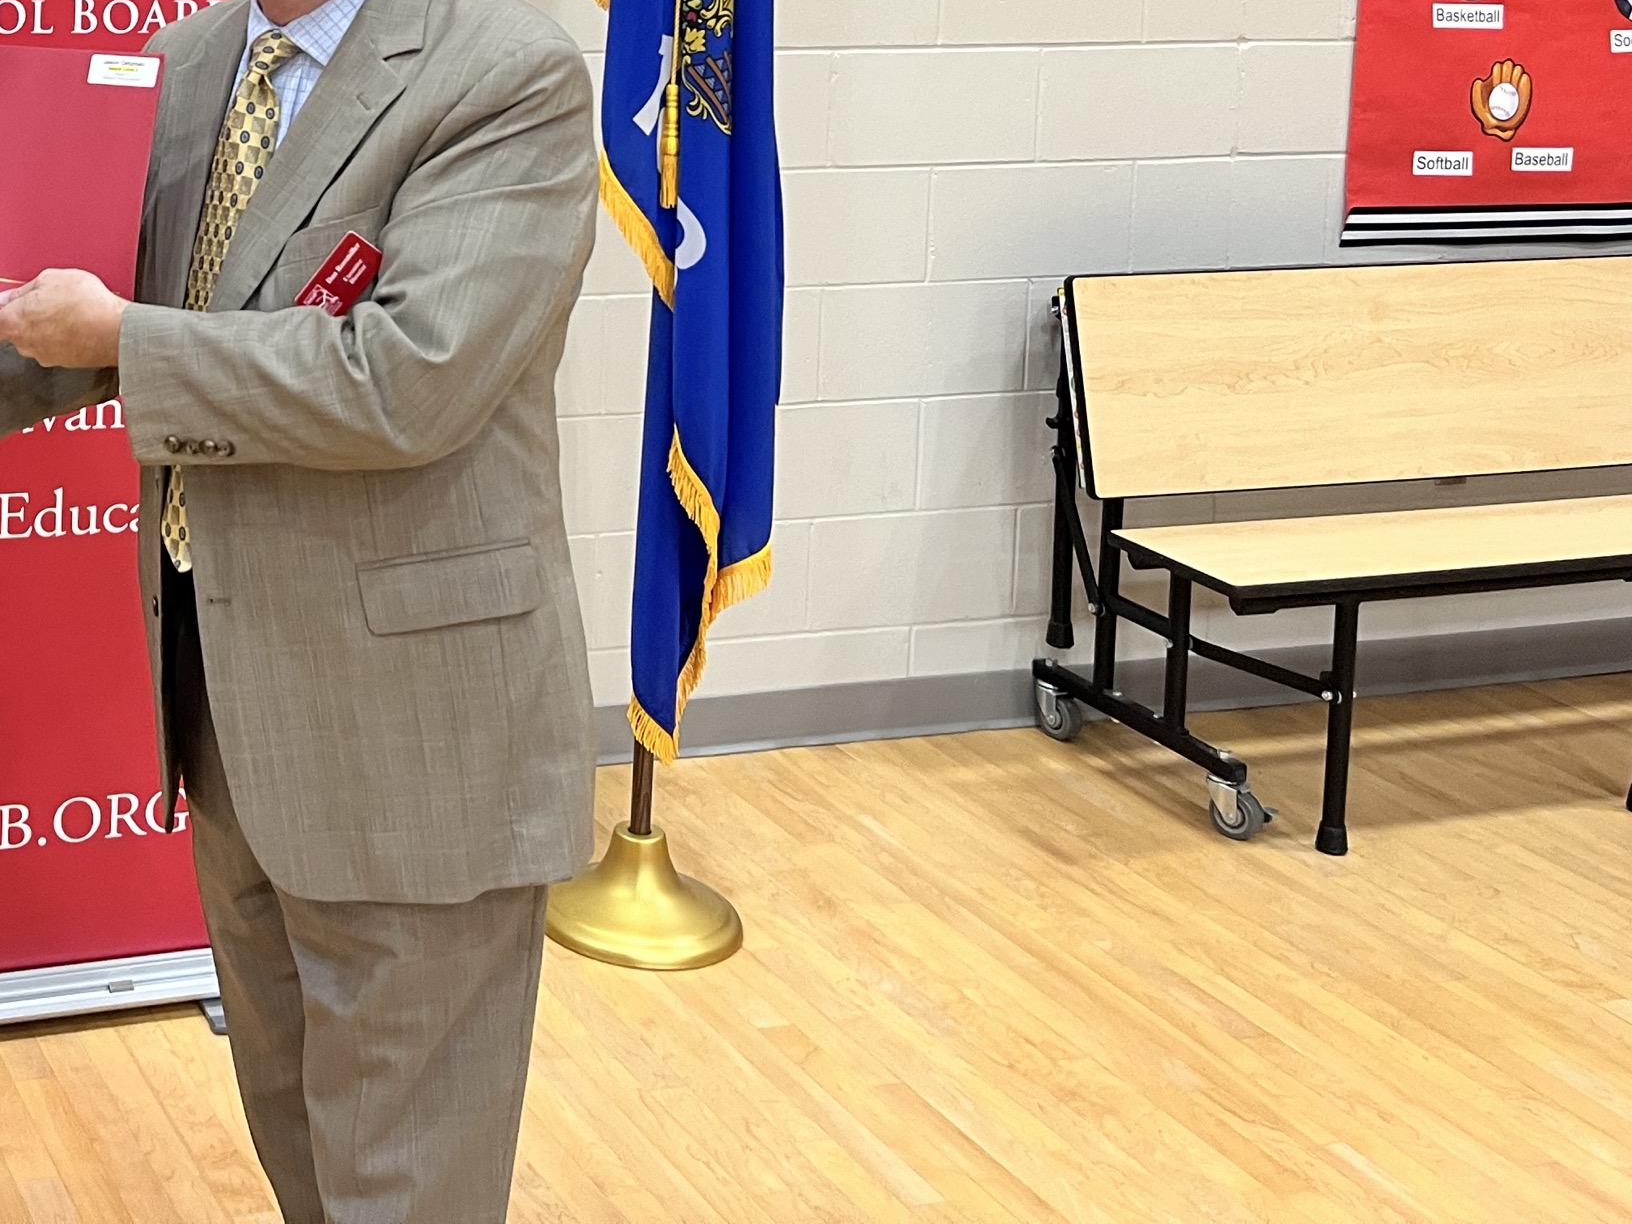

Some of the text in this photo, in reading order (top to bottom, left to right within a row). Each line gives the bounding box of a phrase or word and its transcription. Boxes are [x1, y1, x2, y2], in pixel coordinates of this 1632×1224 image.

[1436, 8, 1500, 23] Basketball
[1614, 33, 1632, 47] So
[1416, 156, 1469, 170] Softball
[1514, 152, 1568, 167] Baseball
